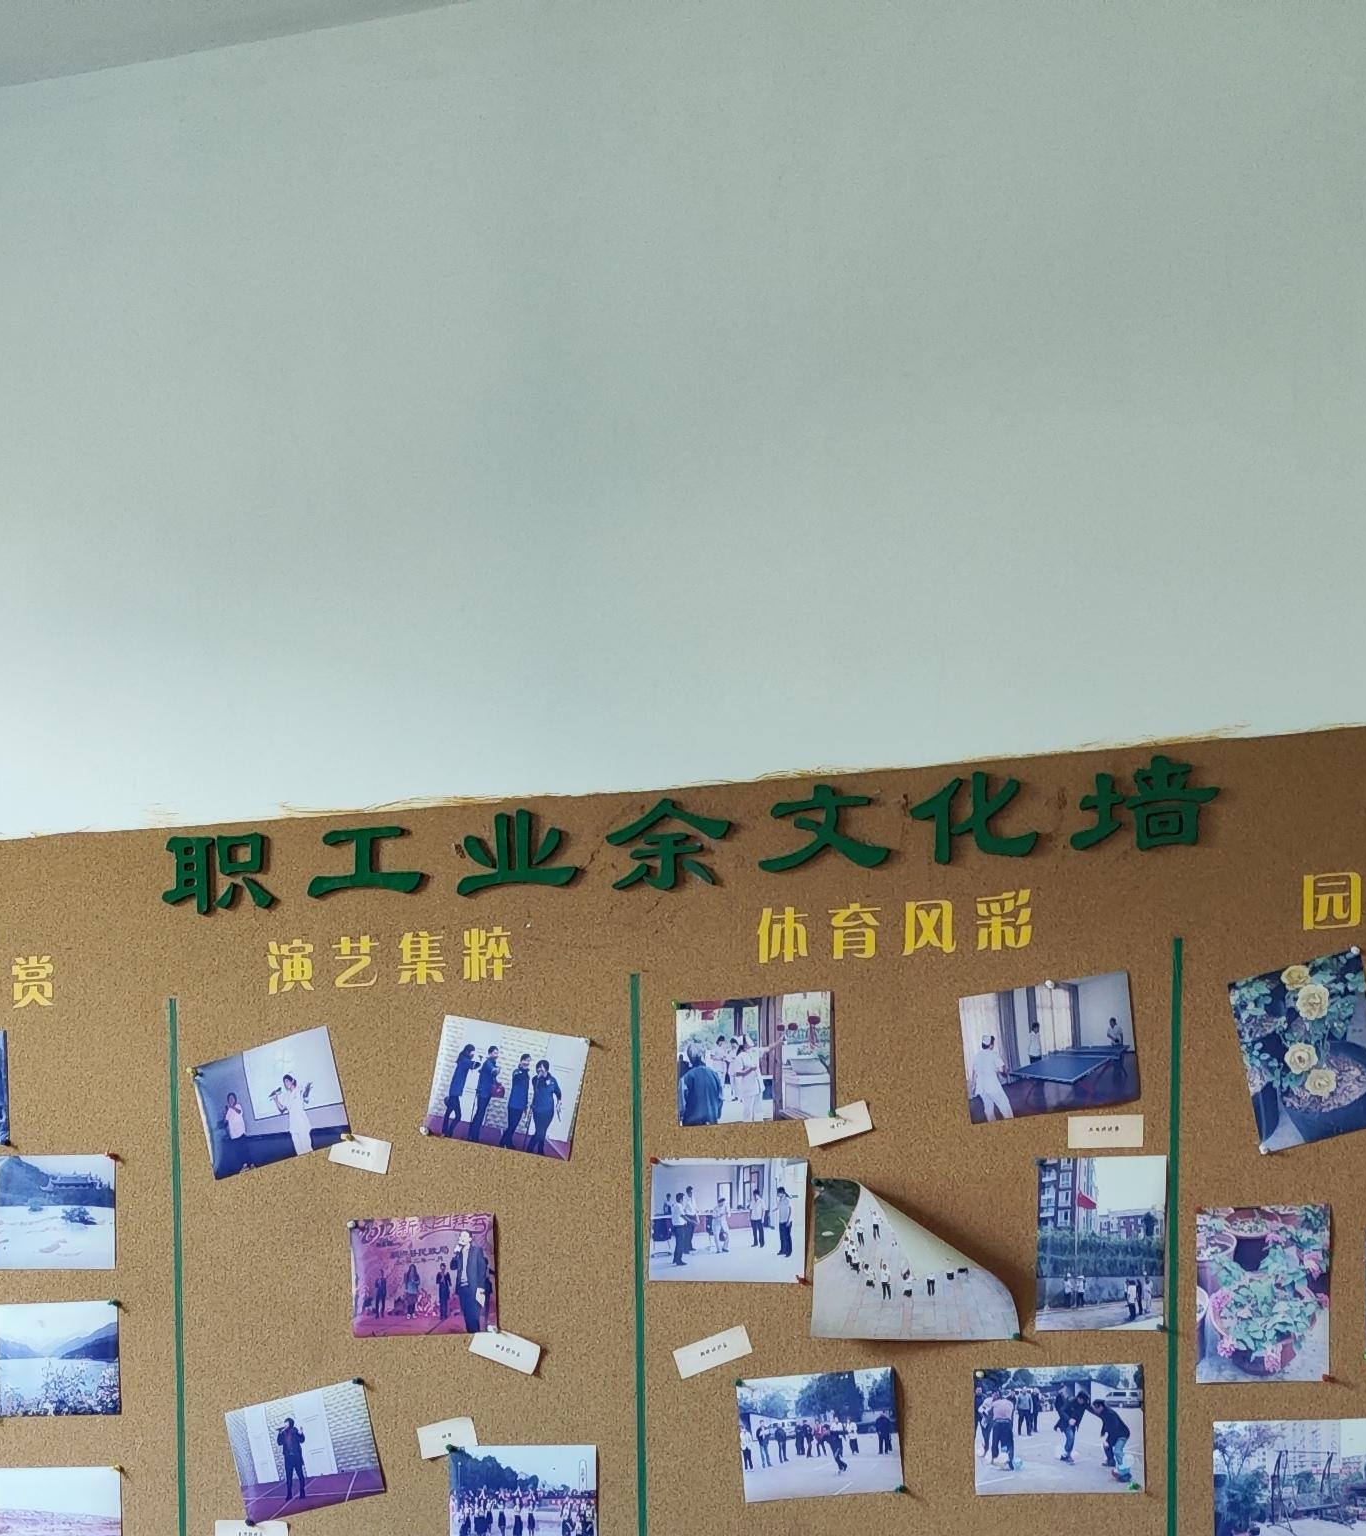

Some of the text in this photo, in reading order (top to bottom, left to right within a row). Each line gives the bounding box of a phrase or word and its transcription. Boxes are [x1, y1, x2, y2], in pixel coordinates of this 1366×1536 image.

[161, 754, 1221, 914] 职工业余文化墙
[266, 925, 514, 995] 演艺集粹
[756, 888, 1033, 966] 体育风彩
